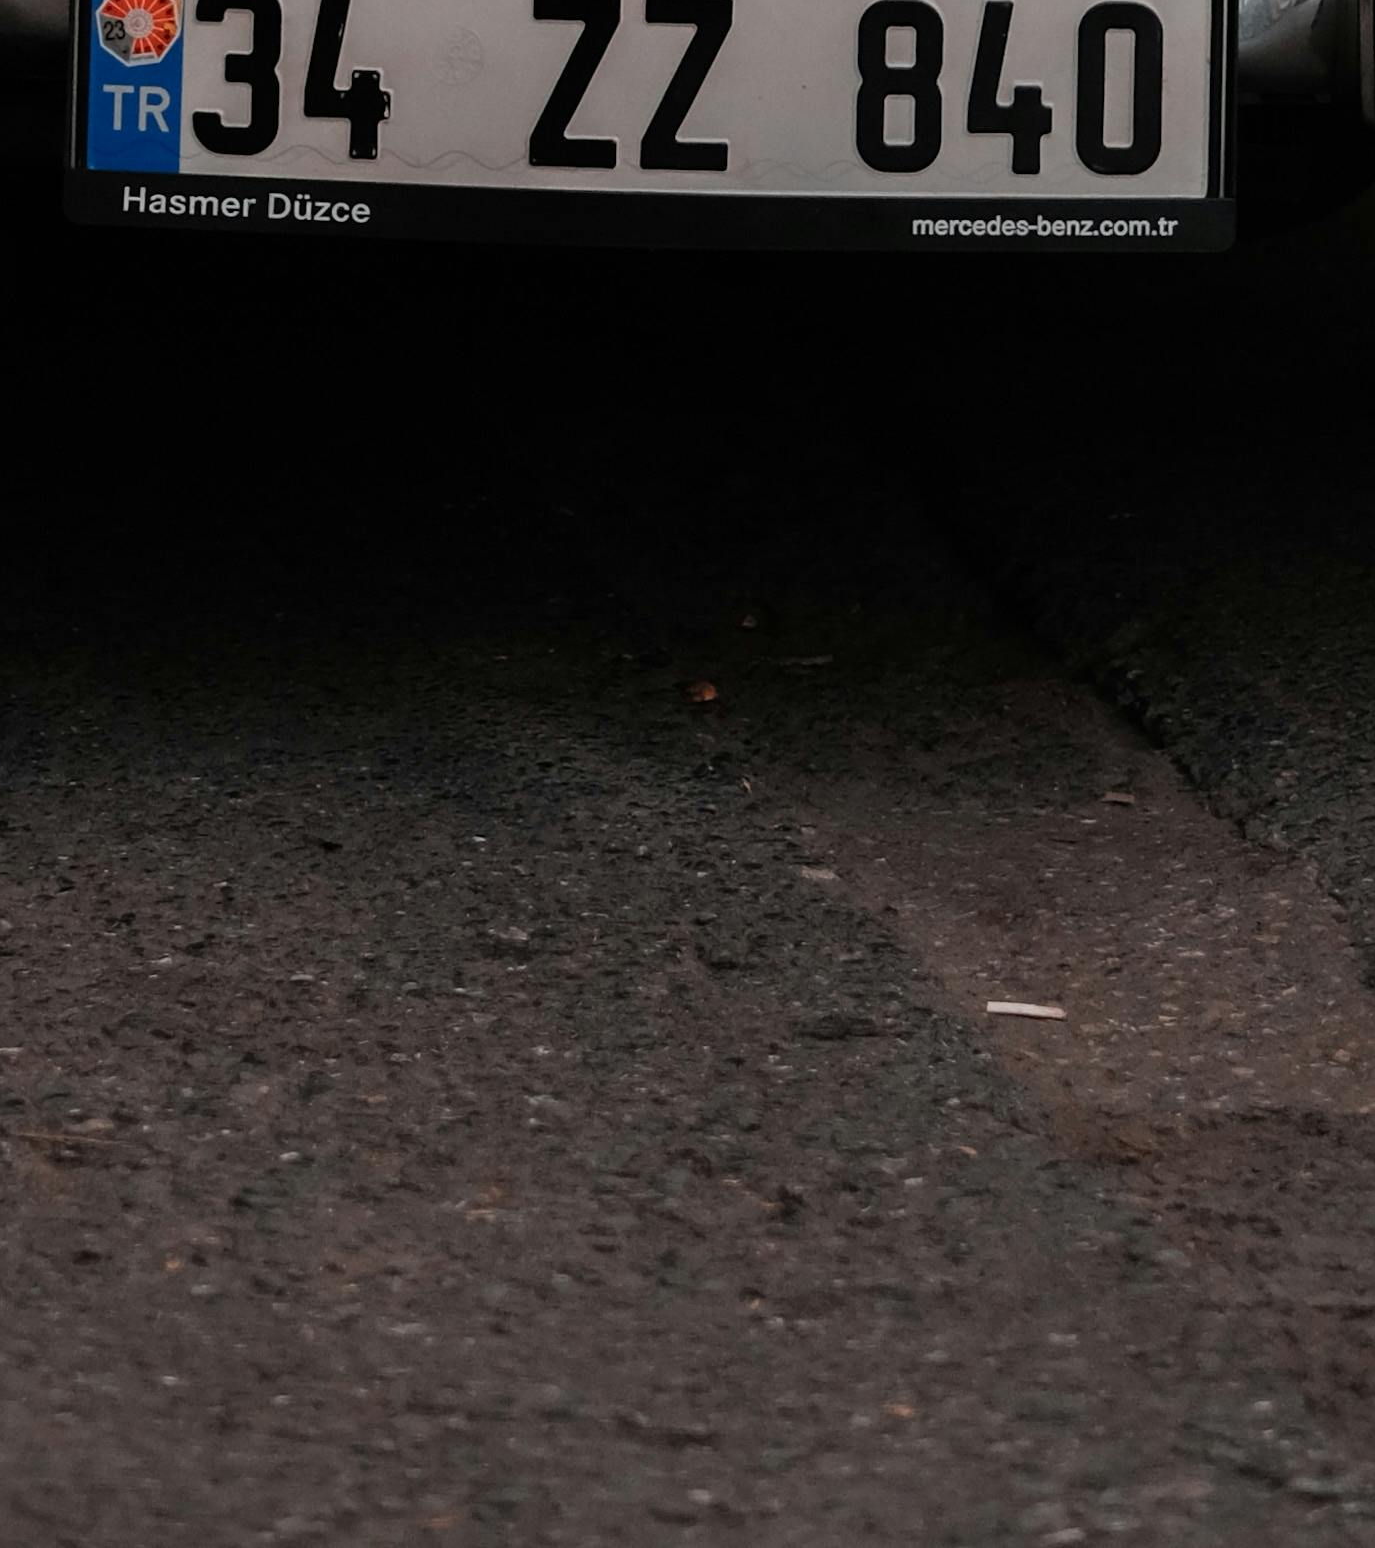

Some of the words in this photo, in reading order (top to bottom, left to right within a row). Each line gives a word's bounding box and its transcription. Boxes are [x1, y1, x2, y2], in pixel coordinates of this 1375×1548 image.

[103, 19, 126, 41] 23
[103, 84, 171, 133] TR
[122, 185, 257, 219] Hasmer
[267, 192, 371, 224] Düzce
[912, 214, 1179, 238] mercedes-benz.com.tr
